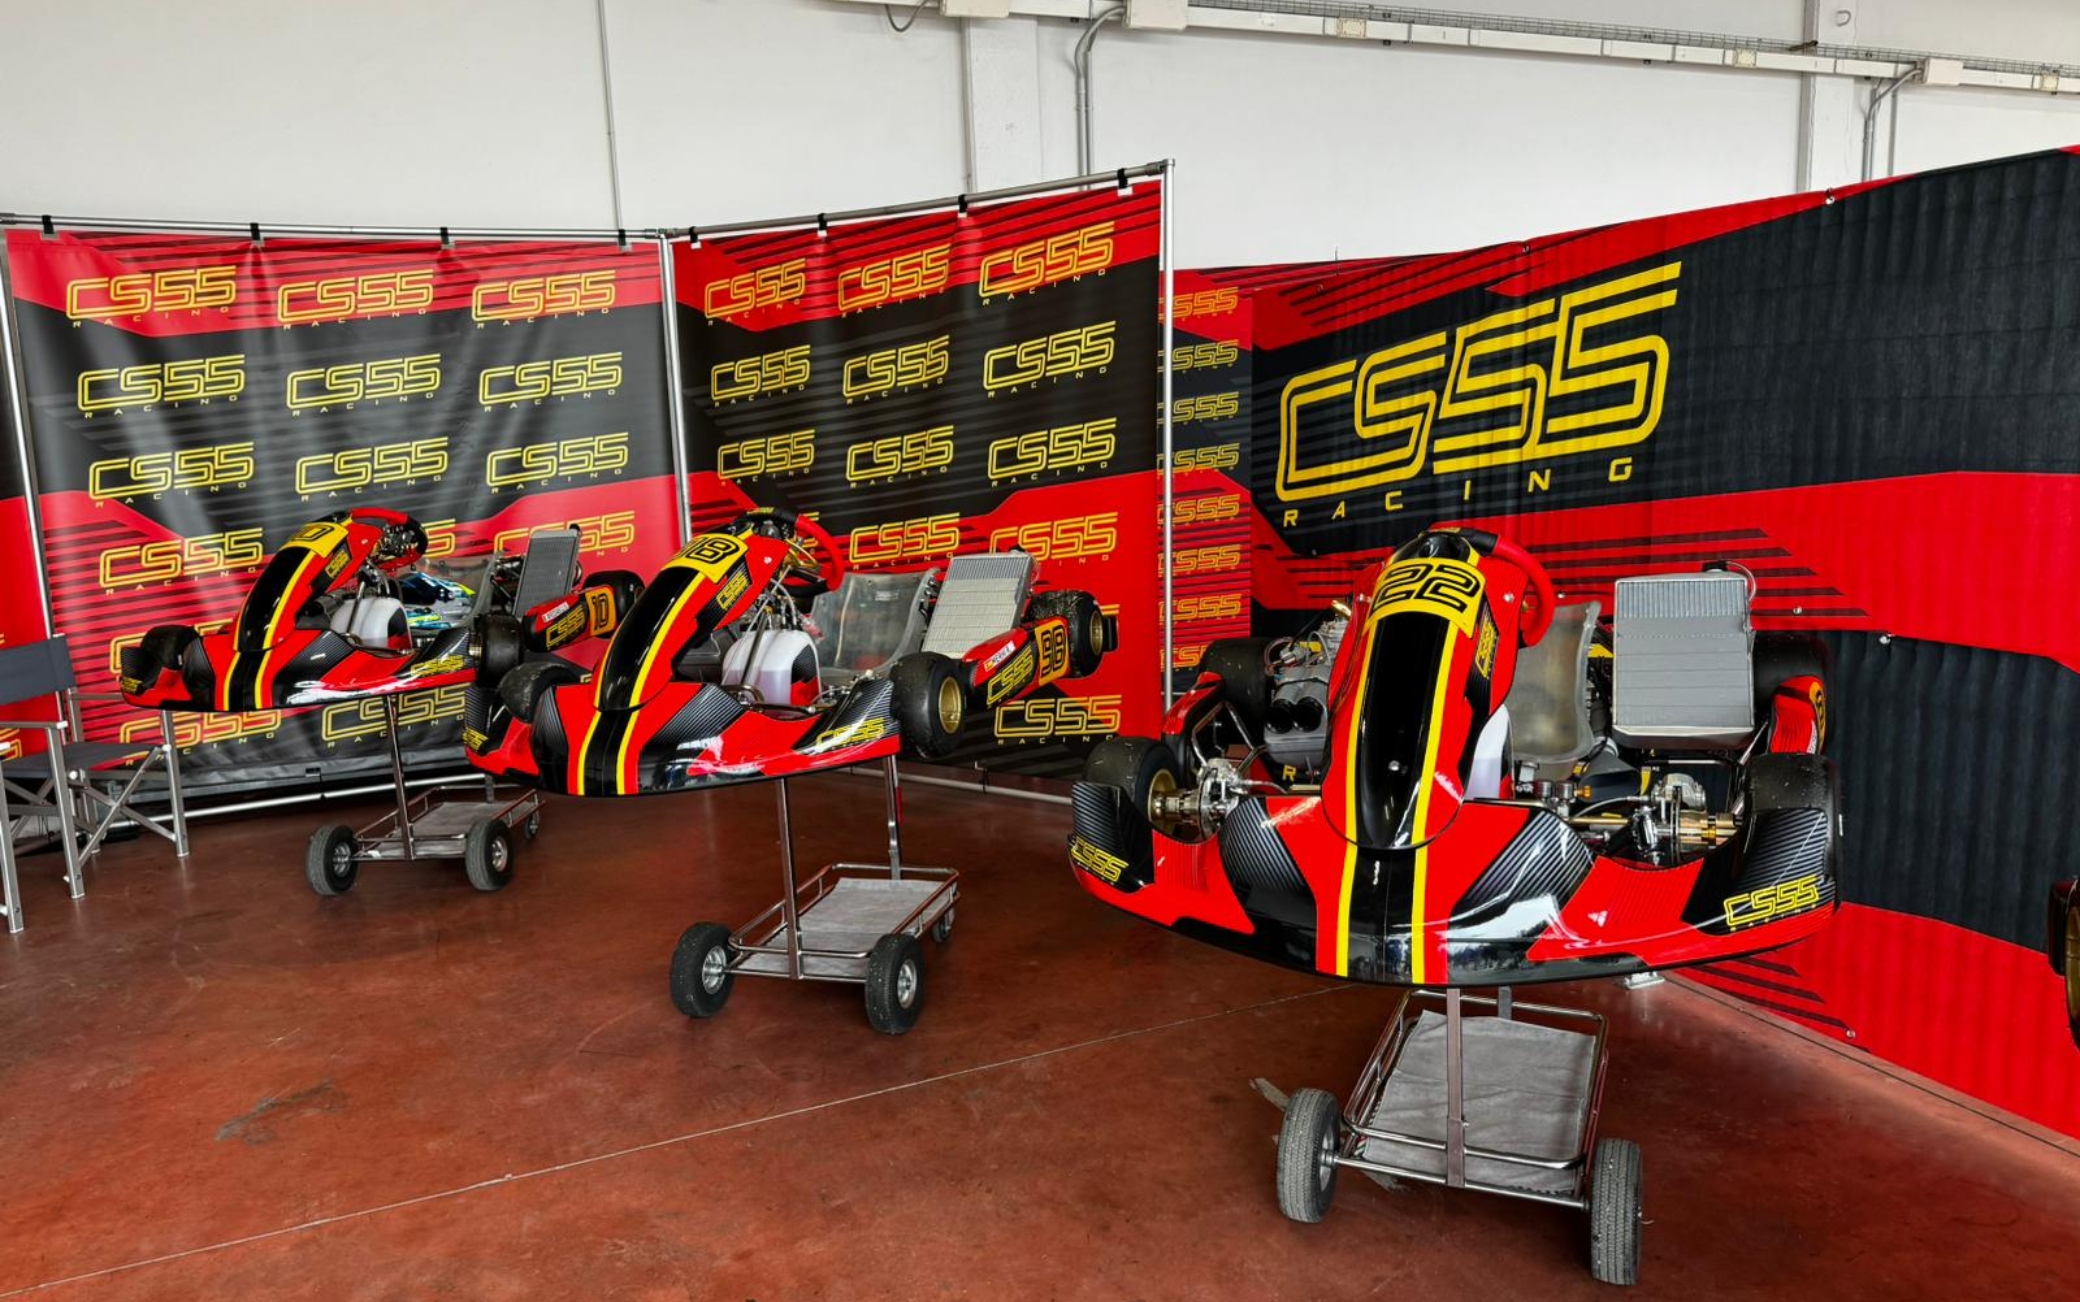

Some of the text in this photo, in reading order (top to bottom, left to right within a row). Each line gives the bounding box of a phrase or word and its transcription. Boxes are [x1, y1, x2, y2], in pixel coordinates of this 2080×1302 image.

[838, 243, 951, 311] CS55
[979, 220, 1115, 297] CS55
[66, 265, 237, 320] CS55
[278, 269, 434, 322] CS55
[472, 270, 616, 321] CS55
[705, 258, 806, 319] CS55
[708, 299, 800, 326] RACING
[982, 268, 1106, 305] RACING
[73, 306, 229, 328] RACING
[283, 308, 426, 329] RACING
[477, 308, 609, 329] RACING
[287, 353, 442, 409] CS55
[479, 352, 623, 405] CS55
[711, 344, 811, 400] CS55
[843, 335, 950, 398] CS55
[983, 320, 1116, 391] CS55
[1276, 261, 1682, 501] CS55
[78, 354, 245, 411] CS55
[84, 394, 238, 419] RACING
[292, 392, 434, 416] RACING
[484, 389, 616, 413] RACING
[714, 384, 804, 408] RACING
[847, 377, 943, 405] RACING
[987, 366, 1108, 398] RACING
[89, 442, 254, 500] CS55
[296, 437, 449, 494] CS55
[486, 432, 629, 487] CS55
[717, 429, 816, 481] CS55
[846, 425, 954, 482] CS55
[988, 417, 1117, 480] CS55
[991, 461, 1108, 488] RACING
[95, 481, 246, 508] RACING
[301, 475, 442, 502] RACING
[491, 467, 622, 494] RACING
[720, 467, 810, 487] RACING
[850, 466, 947, 489] RACING
[1283, 457, 1633, 528] RACING
[100, 527, 263, 588] CS55
[850, 512, 960, 564] CS55
[105, 567, 256, 596] RACING
[1372, 564, 1482, 617] 22
[994, 694, 1122, 737] CS55
[1723, 874, 1820, 927] CS55
